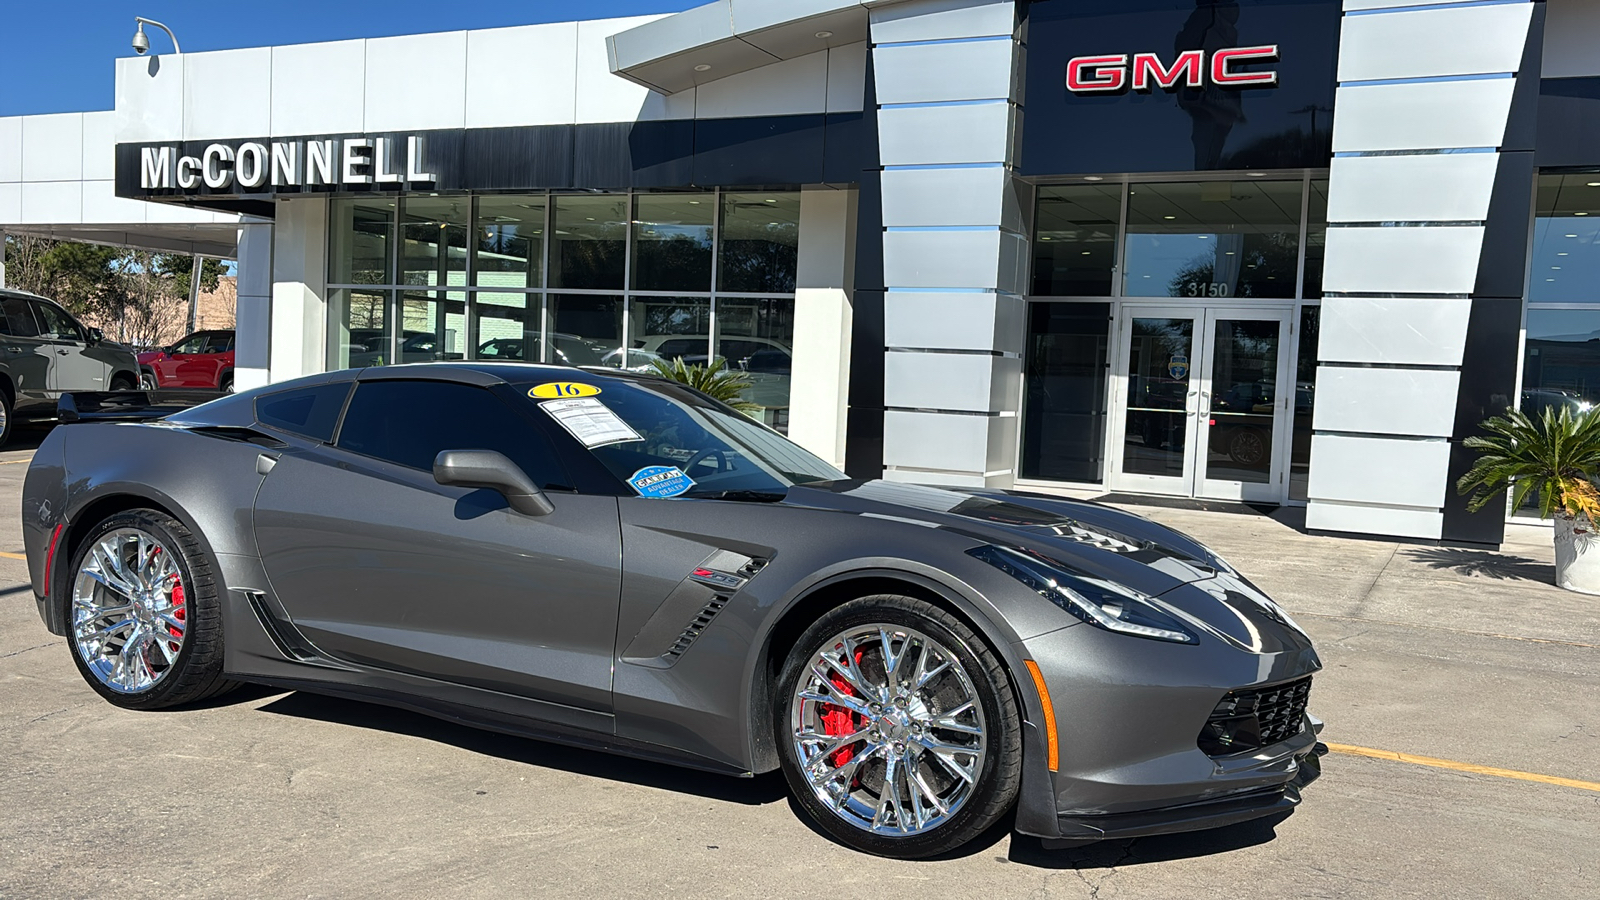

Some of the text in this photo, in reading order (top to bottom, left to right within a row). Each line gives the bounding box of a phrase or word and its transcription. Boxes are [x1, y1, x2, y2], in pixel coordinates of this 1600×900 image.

[1066, 44, 1280, 92] GMC
[141, 136, 436, 190] McCONNELL
[1188, 282, 1228, 298] 3150
[553, 383, 580, 397] 16
[647, 477, 685, 493] ADVANTAGE
[659, 484, 685, 496] DEALER
